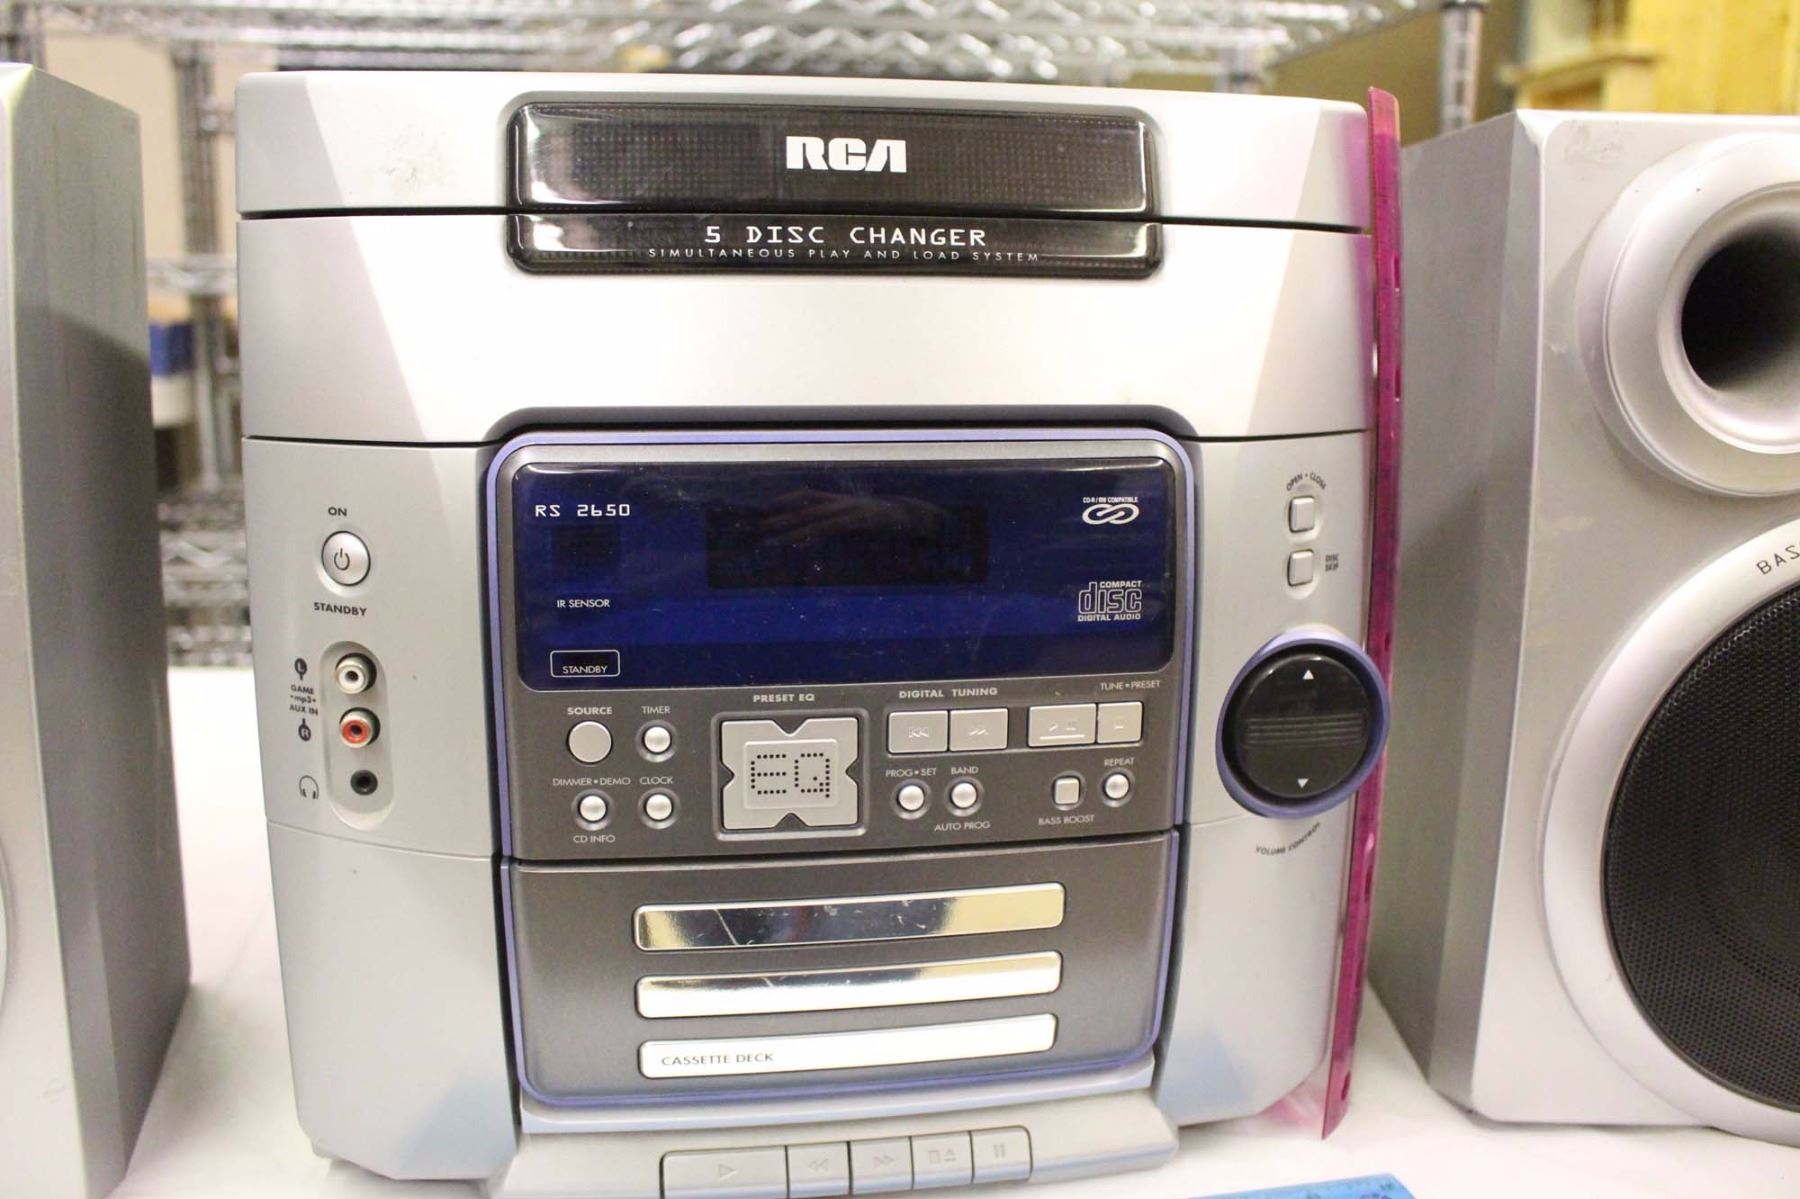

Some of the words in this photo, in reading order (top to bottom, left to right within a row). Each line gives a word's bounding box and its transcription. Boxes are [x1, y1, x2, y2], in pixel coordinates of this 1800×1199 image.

[785, 135, 907, 173] RCA
[704, 225, 721, 244] 5
[746, 225, 825, 244] DISC
[849, 226, 986, 247] CHANGER
[648, 248, 796, 259] SIMULTANEOUS
[808, 249, 850, 259] PLAY
[863, 249, 901, 260] AND
[912, 250, 960, 261] LOAD
[971, 251, 1039, 263] SYSTEM
[327, 506, 348, 518] ON
[535, 504, 561, 518] RS
[576, 503, 631, 517] 2650
[1099, 580, 1142, 589] COMPACT
[313, 601, 368, 617] STANDBY
[556, 599, 566, 609] IR
[568, 598, 611, 609] SENSOR
[1077, 613, 1112, 622] DIGITAL
[1113, 613, 1142, 621] AUDIO
[562, 664, 608, 675] STANDBY
[290, 684, 314, 695] GAME
[898, 688, 945, 699] DIGITAL
[951, 686, 998, 698] TUNING
[752, 693, 795, 704] PRESET
[798, 692, 816, 703] EQ
[289, 703, 306, 714] AUX
[308, 706, 319, 716] IN
[566, 705, 613, 716] SOURCE
[641, 705, 671, 715] TIMER
[1103, 757, 1136, 768] REPEAT
[750, 753, 831, 799] EQ
[950, 765, 979, 775] BAND
[638, 775, 674, 786] CLOCK
[933, 822, 961, 832] AUTO
[963, 820, 991, 831] PROG
[1038, 816, 1062, 826] BASS
[1063, 814, 1095, 825] BOOST
[572, 834, 587, 845] CD
[589, 833, 616, 844] INFO
[660, 1054, 731, 1067] CASSETTE
[735, 1052, 774, 1064] DECK
